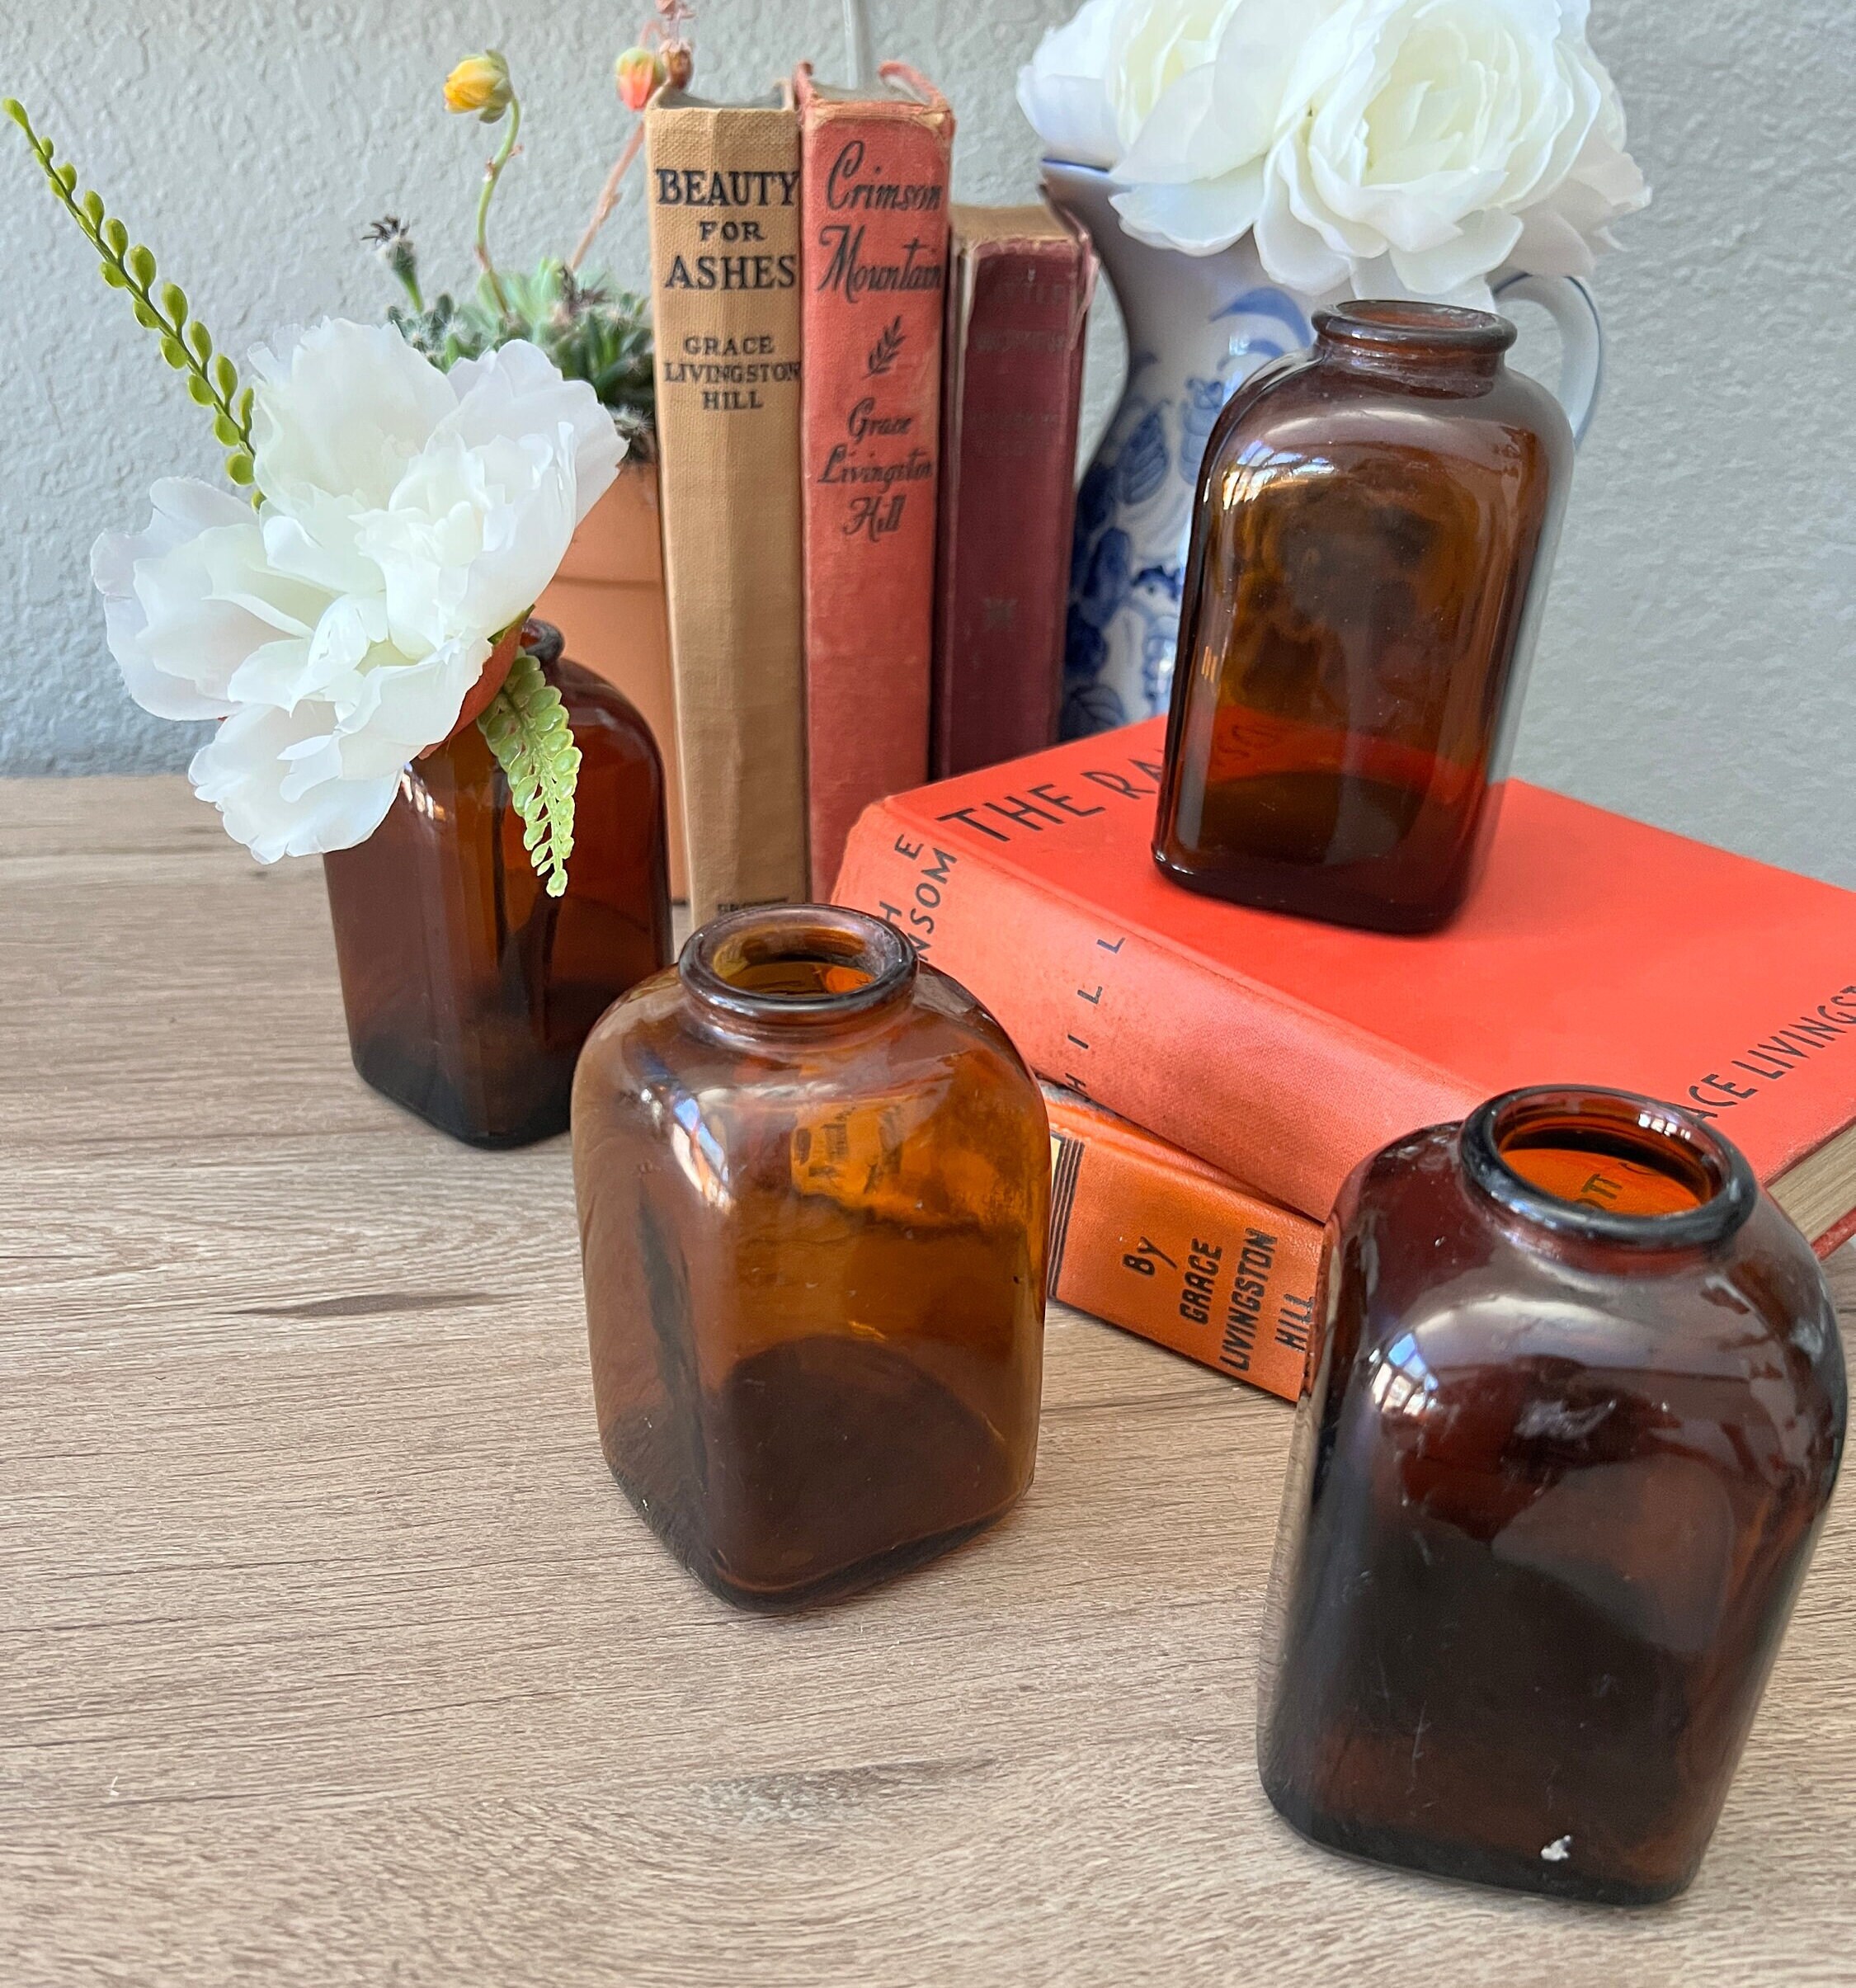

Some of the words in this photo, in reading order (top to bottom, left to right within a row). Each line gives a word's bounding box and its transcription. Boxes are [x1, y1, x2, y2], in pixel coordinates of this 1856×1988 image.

[656, 168, 799, 207] BEAUTY
[827, 140, 941, 211] Crimson
[699, 220, 765, 242] FOR
[664, 253, 797, 290] ASHES
[817, 225, 942, 304] Mountain
[682, 335, 775, 355] GRACE
[663, 360, 801, 383] LIVINGSTON
[702, 391, 764, 410] HILL
[847, 397, 912, 439] Grace
[817, 443, 934, 492] Livingston
[842, 498, 906, 543] Hill
[935, 783, 1106, 843] THE
[879, 833, 925, 923] HE
[907, 847, 959, 963] NSOM
[1122, 1236, 1179, 1277] By
[1179, 1237, 1223, 1326] GRACE
[1219, 1227, 1278, 1372] LIVINGSTON
[1274, 1293, 1315, 1352] HILL
